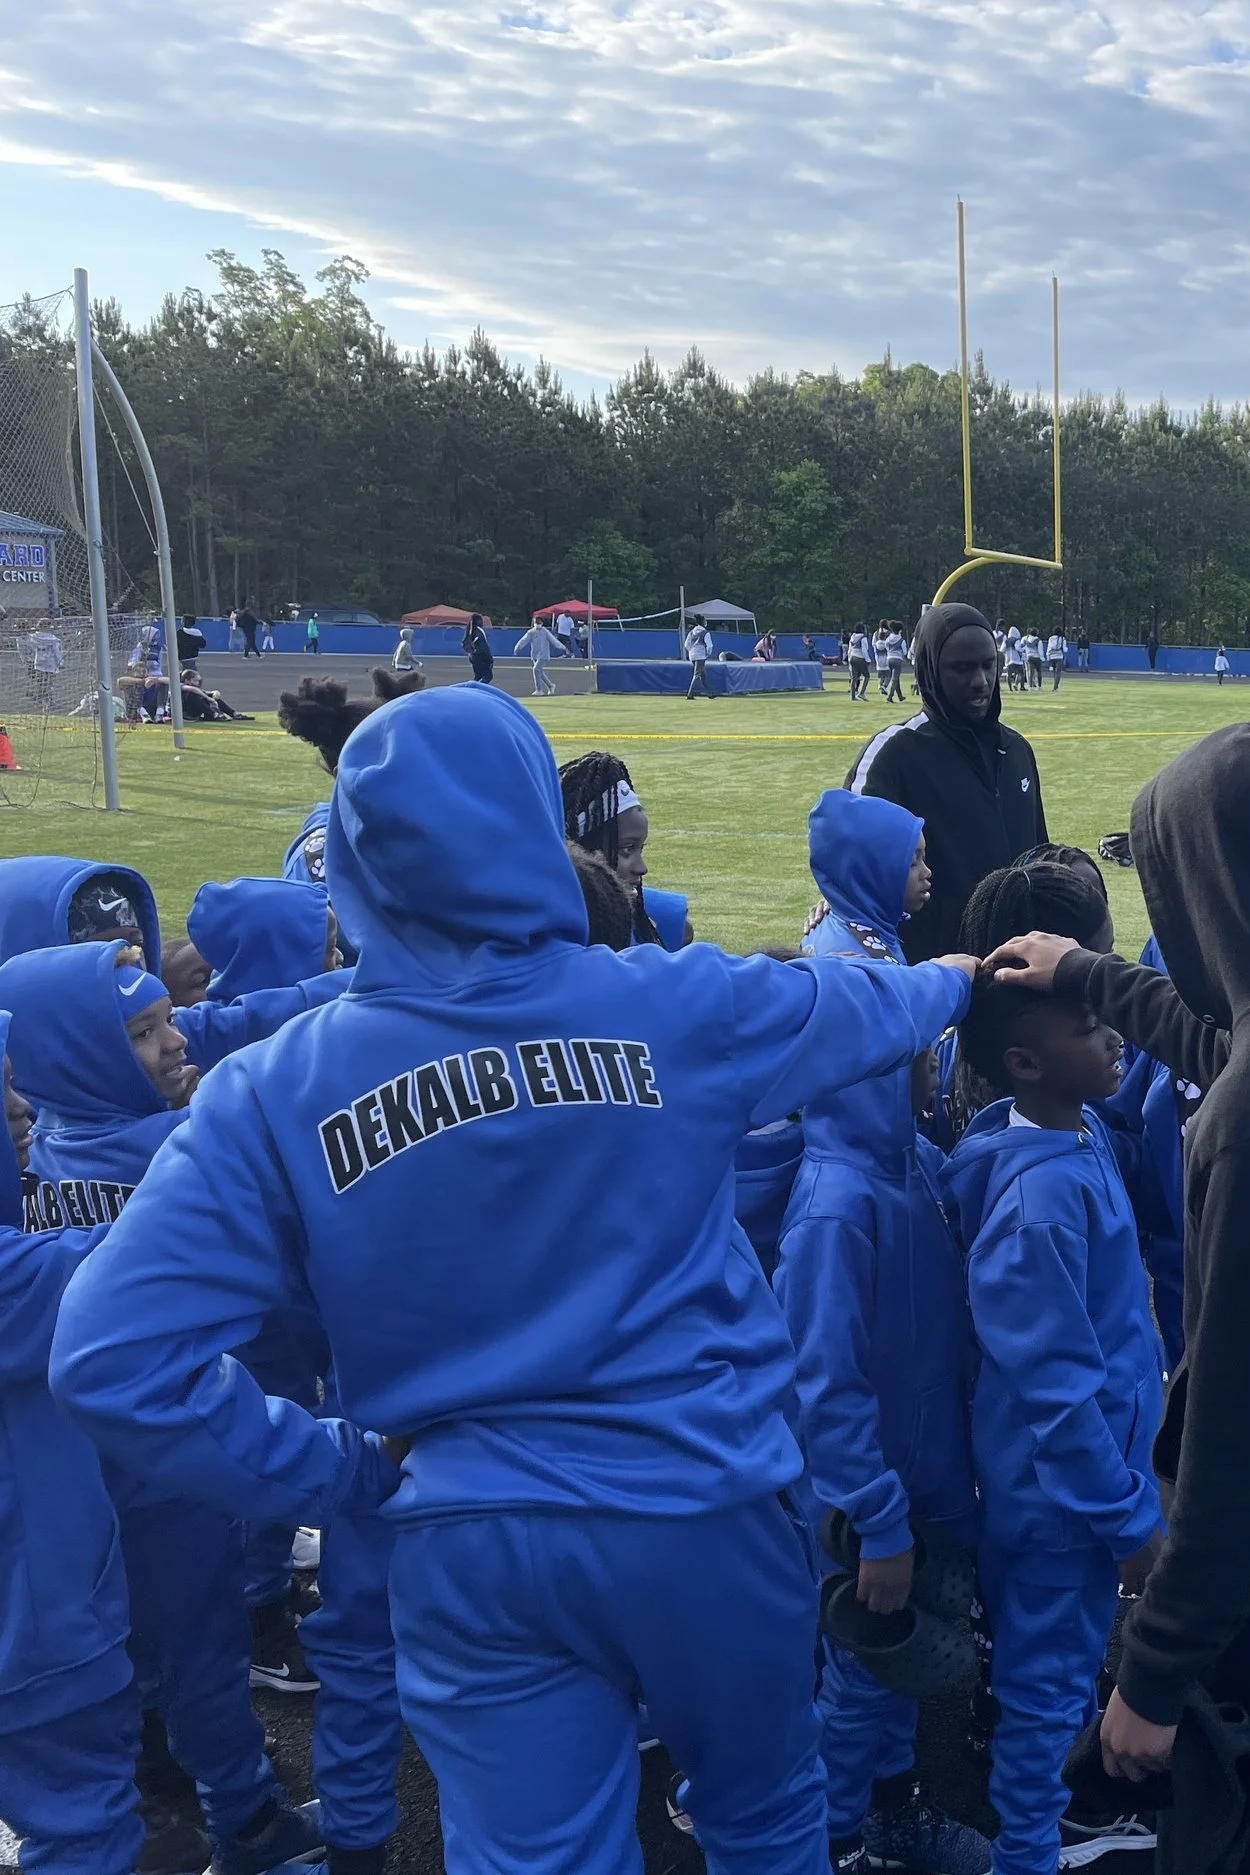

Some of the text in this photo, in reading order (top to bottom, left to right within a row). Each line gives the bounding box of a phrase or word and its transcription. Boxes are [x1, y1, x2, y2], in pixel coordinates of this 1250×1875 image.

[2, 570, 46, 583] CENTER
[317, 1038, 663, 1195] DEKALB ELITE
